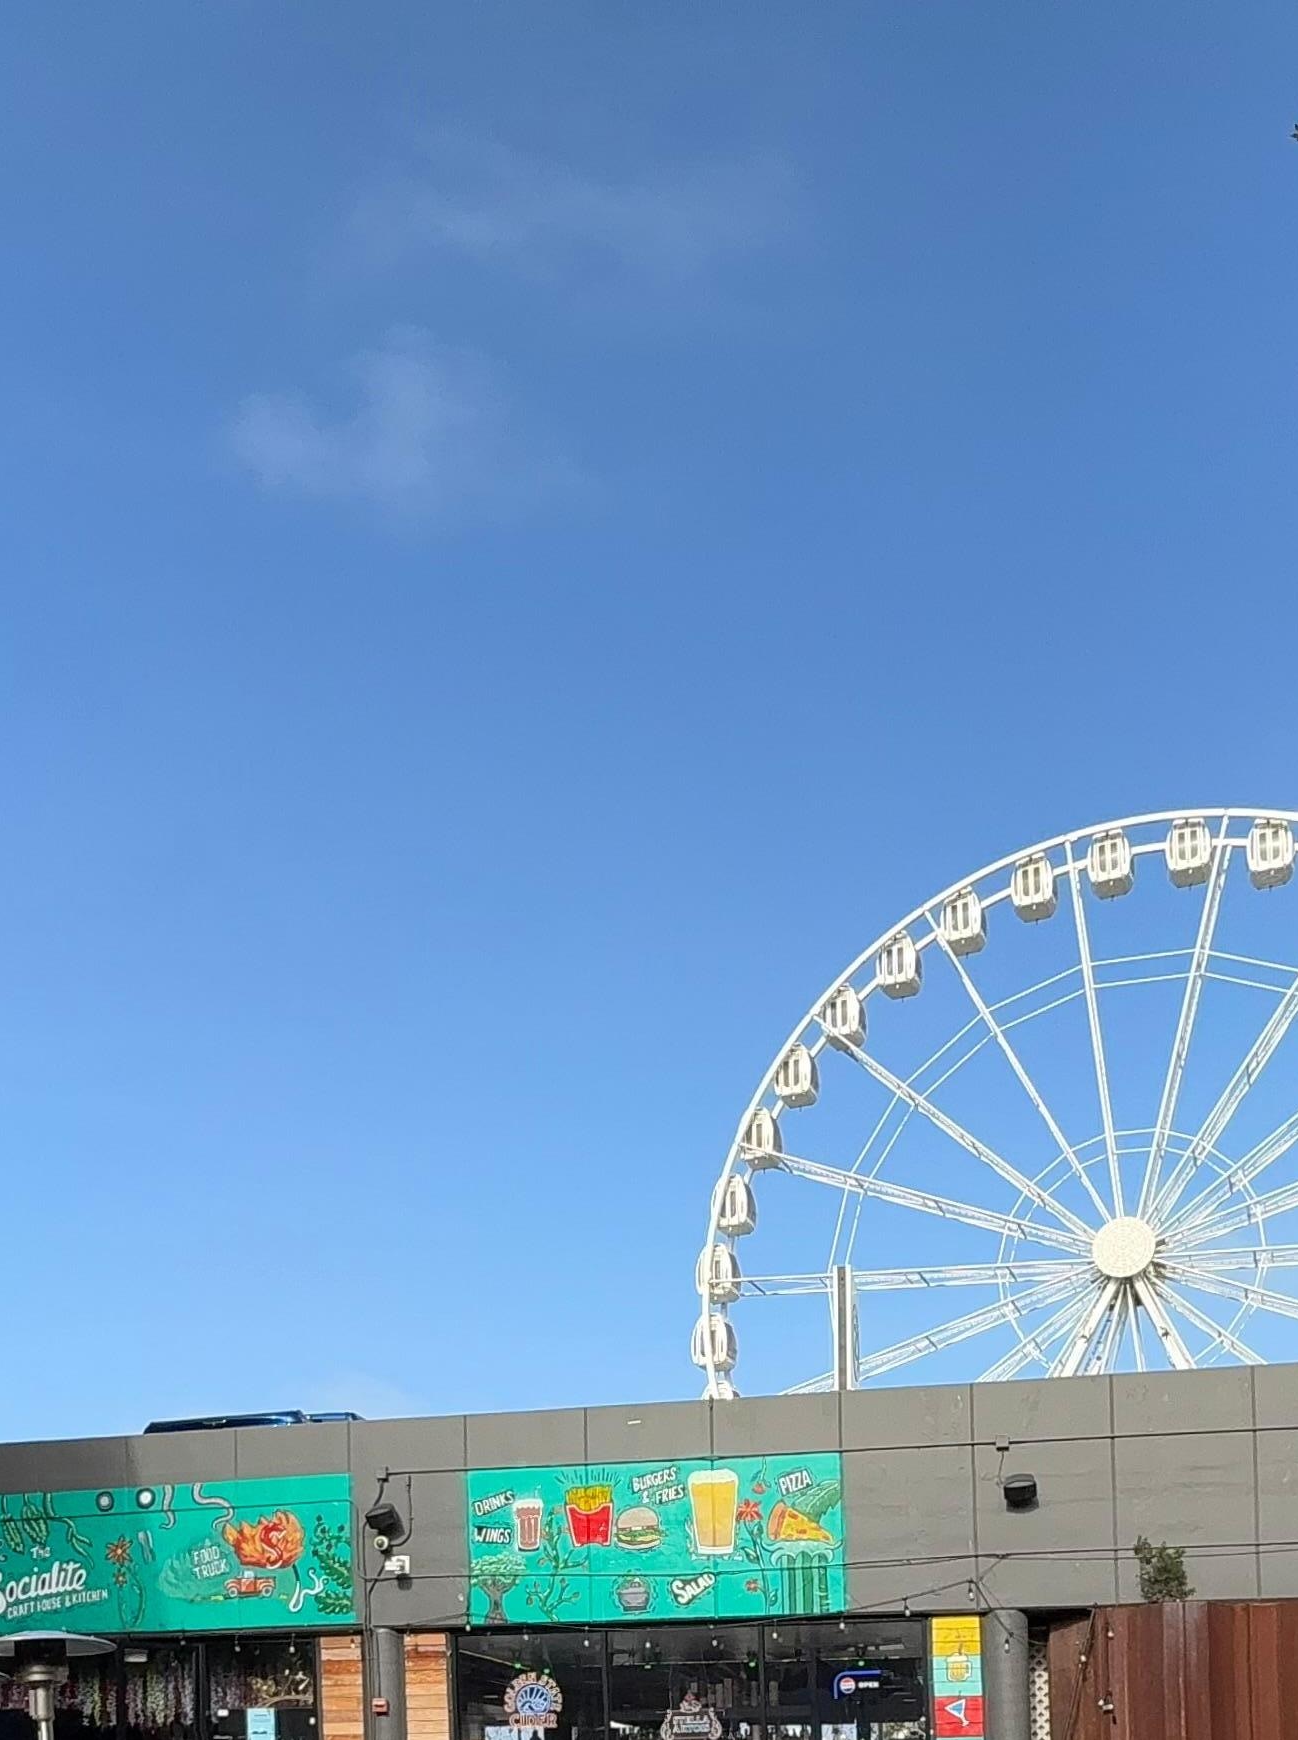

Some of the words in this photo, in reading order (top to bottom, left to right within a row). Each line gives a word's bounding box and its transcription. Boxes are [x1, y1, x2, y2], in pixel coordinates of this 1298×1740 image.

[632, 1467, 677, 1492] BURGERS
[779, 1470, 812, 1495] PIZZA
[474, 1491, 514, 1516] DRINKS
[641, 1491, 650, 1504] &
[655, 1484, 685, 1504] FRIES
[474, 1527, 511, 1544] WINGS
[193, 1546, 220, 1564] FOOD
[192, 1559, 230, 1579] TRUCK
[7, 1601, 34, 1619] CRAFT
[37, 1597, 62, 1611] HOUSE
[73, 1588, 109, 1606] KITCHEN
[508, 1713, 558, 1729] CIDER
